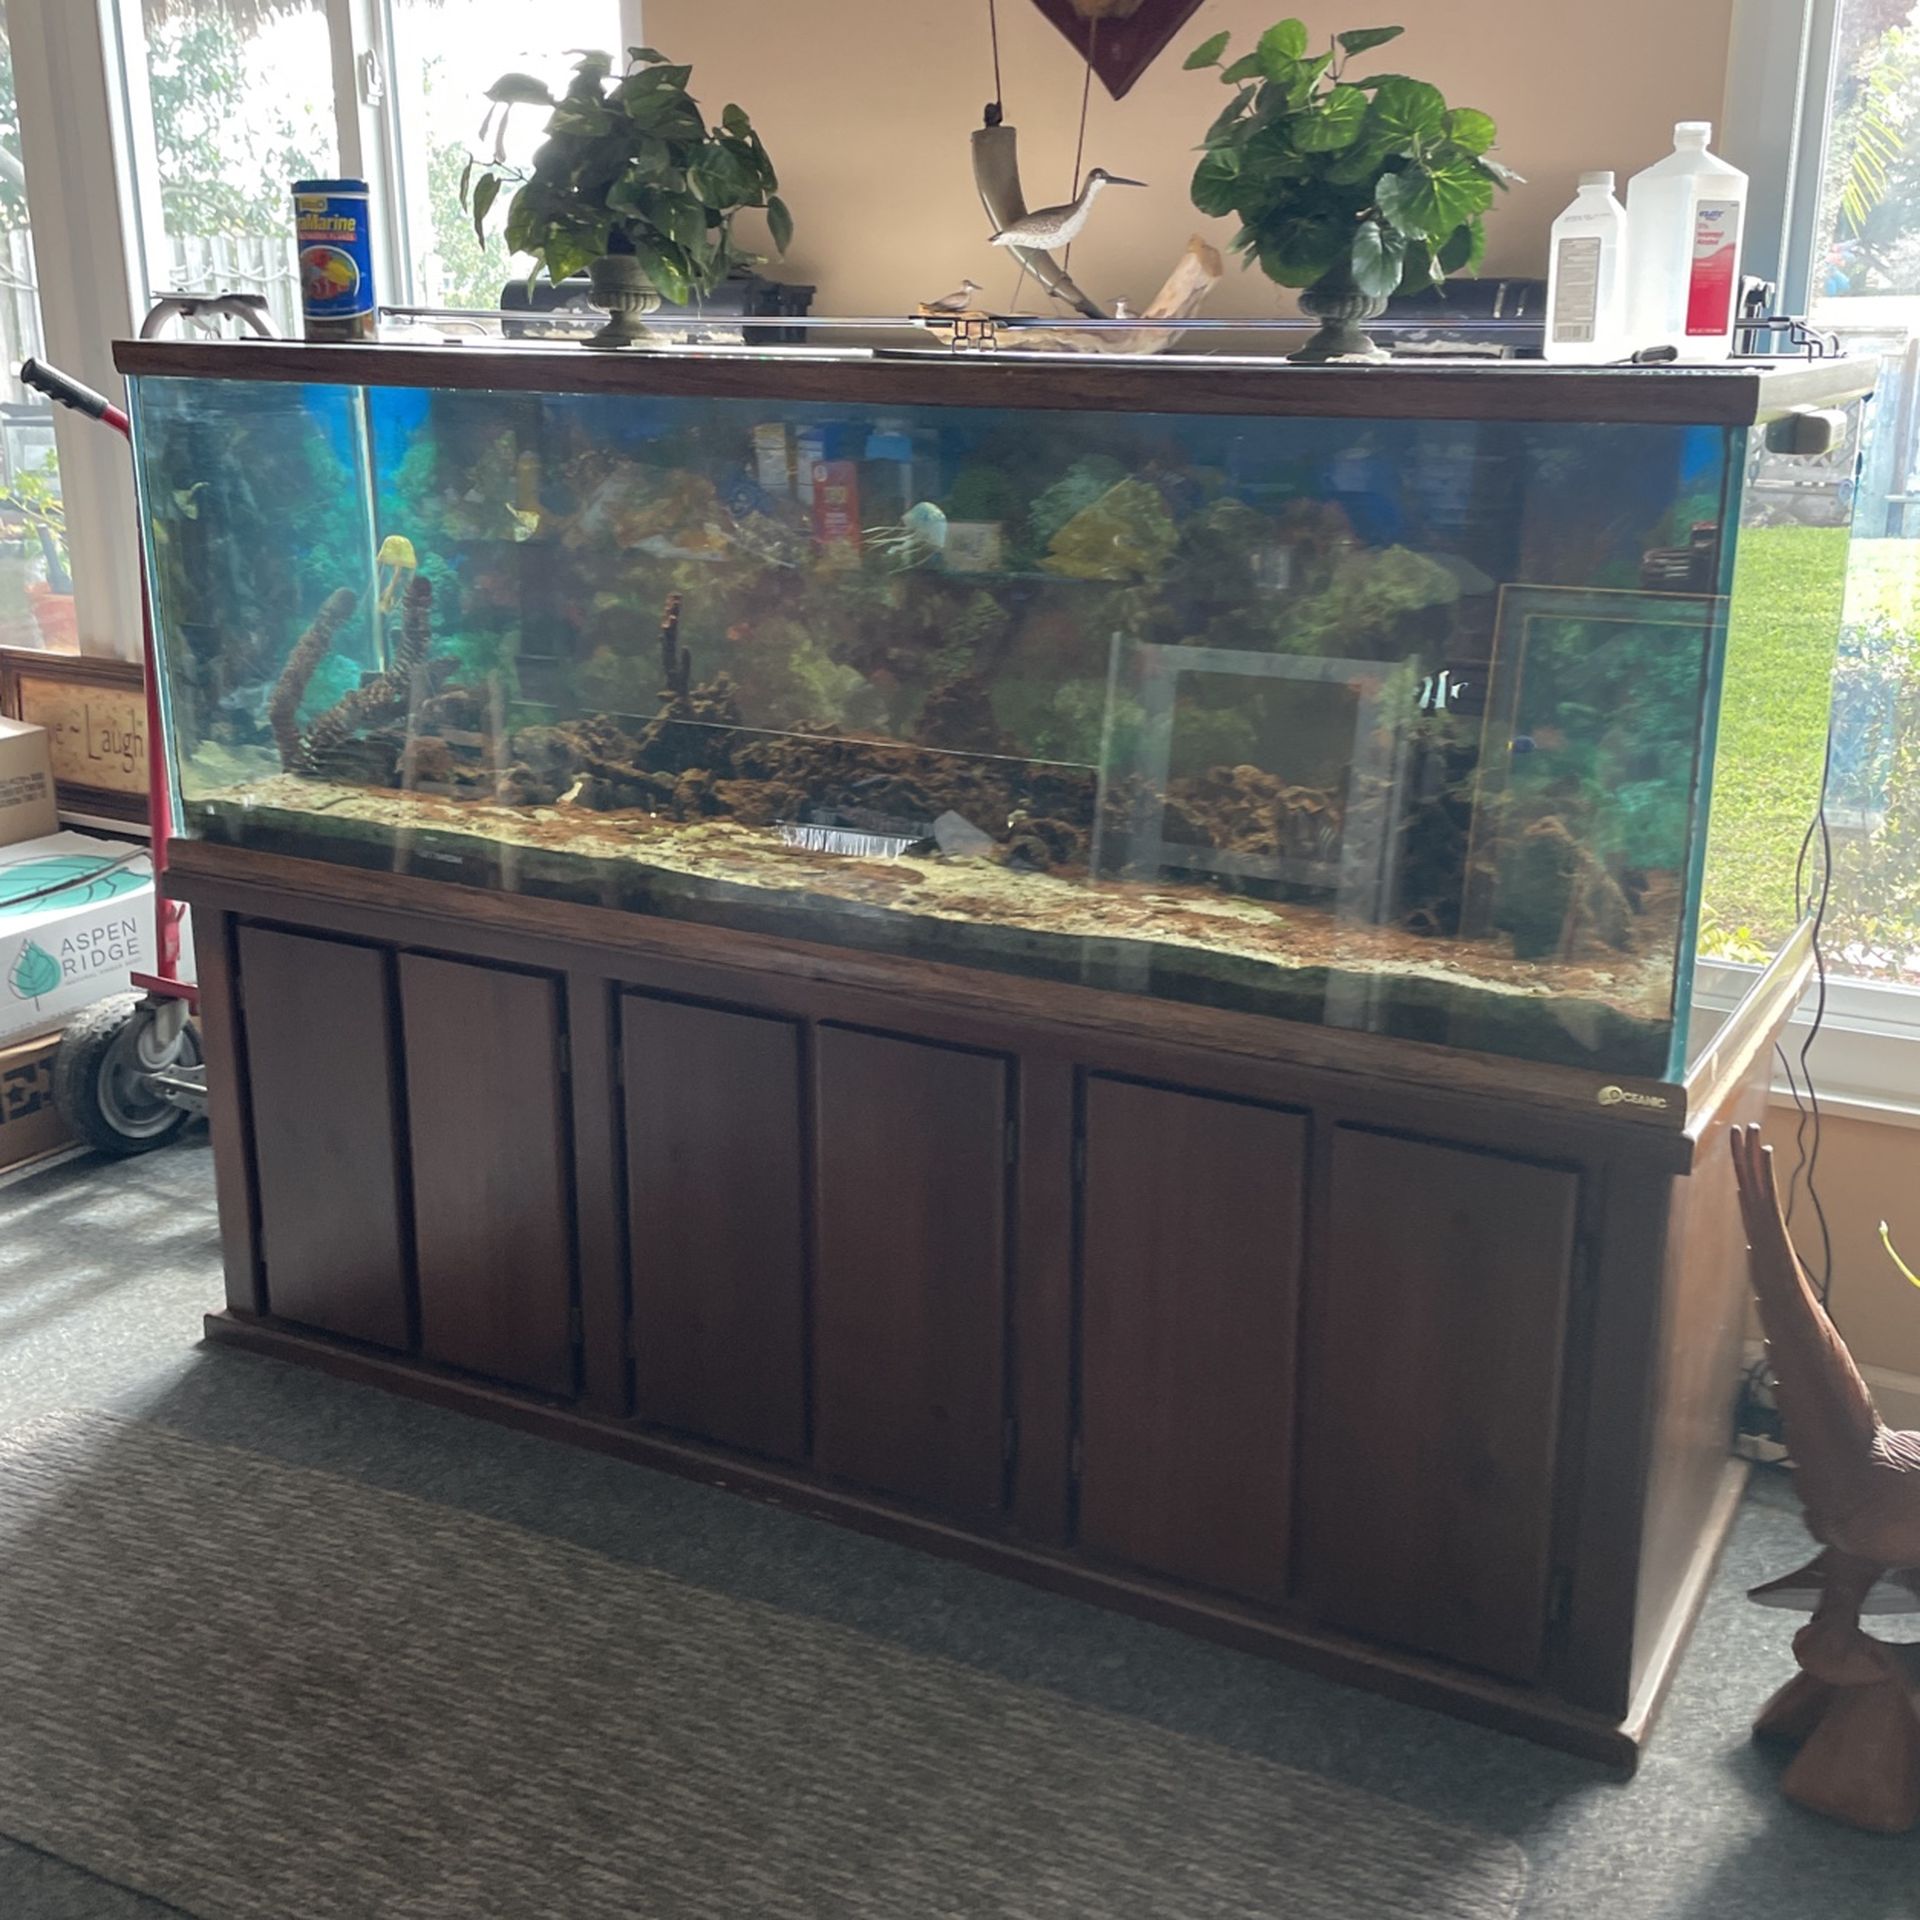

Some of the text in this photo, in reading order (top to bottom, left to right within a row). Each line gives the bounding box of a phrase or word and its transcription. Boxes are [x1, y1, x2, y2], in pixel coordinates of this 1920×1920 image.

[84, 704, 144, 774] Laugh
[61, 916, 137, 956] ASPEN
[62, 937, 140, 977] RIDGE
[1598, 1085, 1668, 1109] OCEANIC
